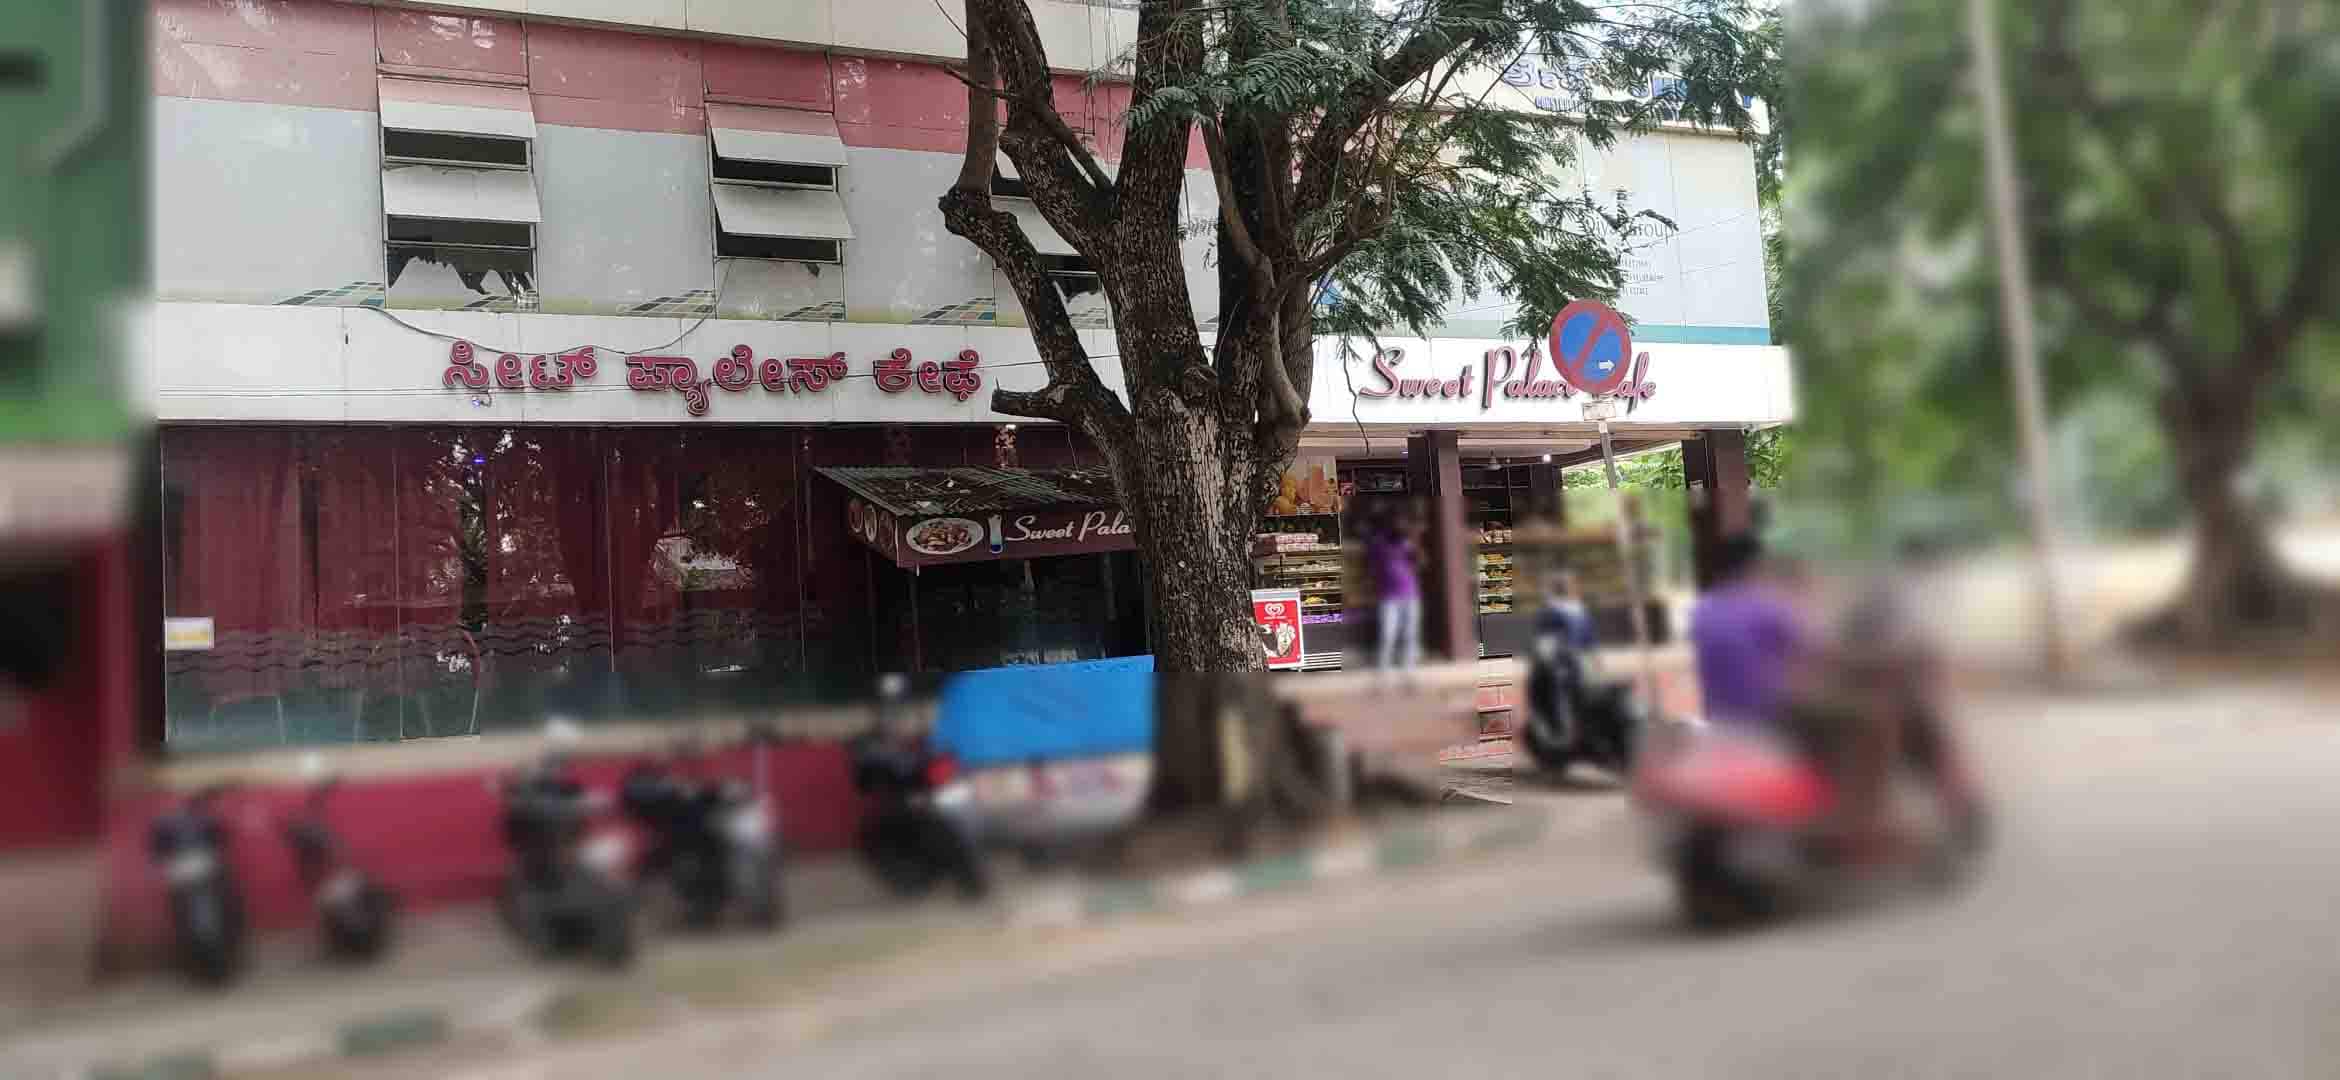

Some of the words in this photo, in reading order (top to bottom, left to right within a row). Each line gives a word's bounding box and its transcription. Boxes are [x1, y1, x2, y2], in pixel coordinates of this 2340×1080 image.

[625, 344, 848, 416] ಪ್ಯಾಲೇಸ್
[1359, 346, 1474, 400] Sweet
[1600, 351, 1656, 415] afe
[1006, 515, 1074, 542] Sweet
[1077, 510, 1132, 543] Pala
